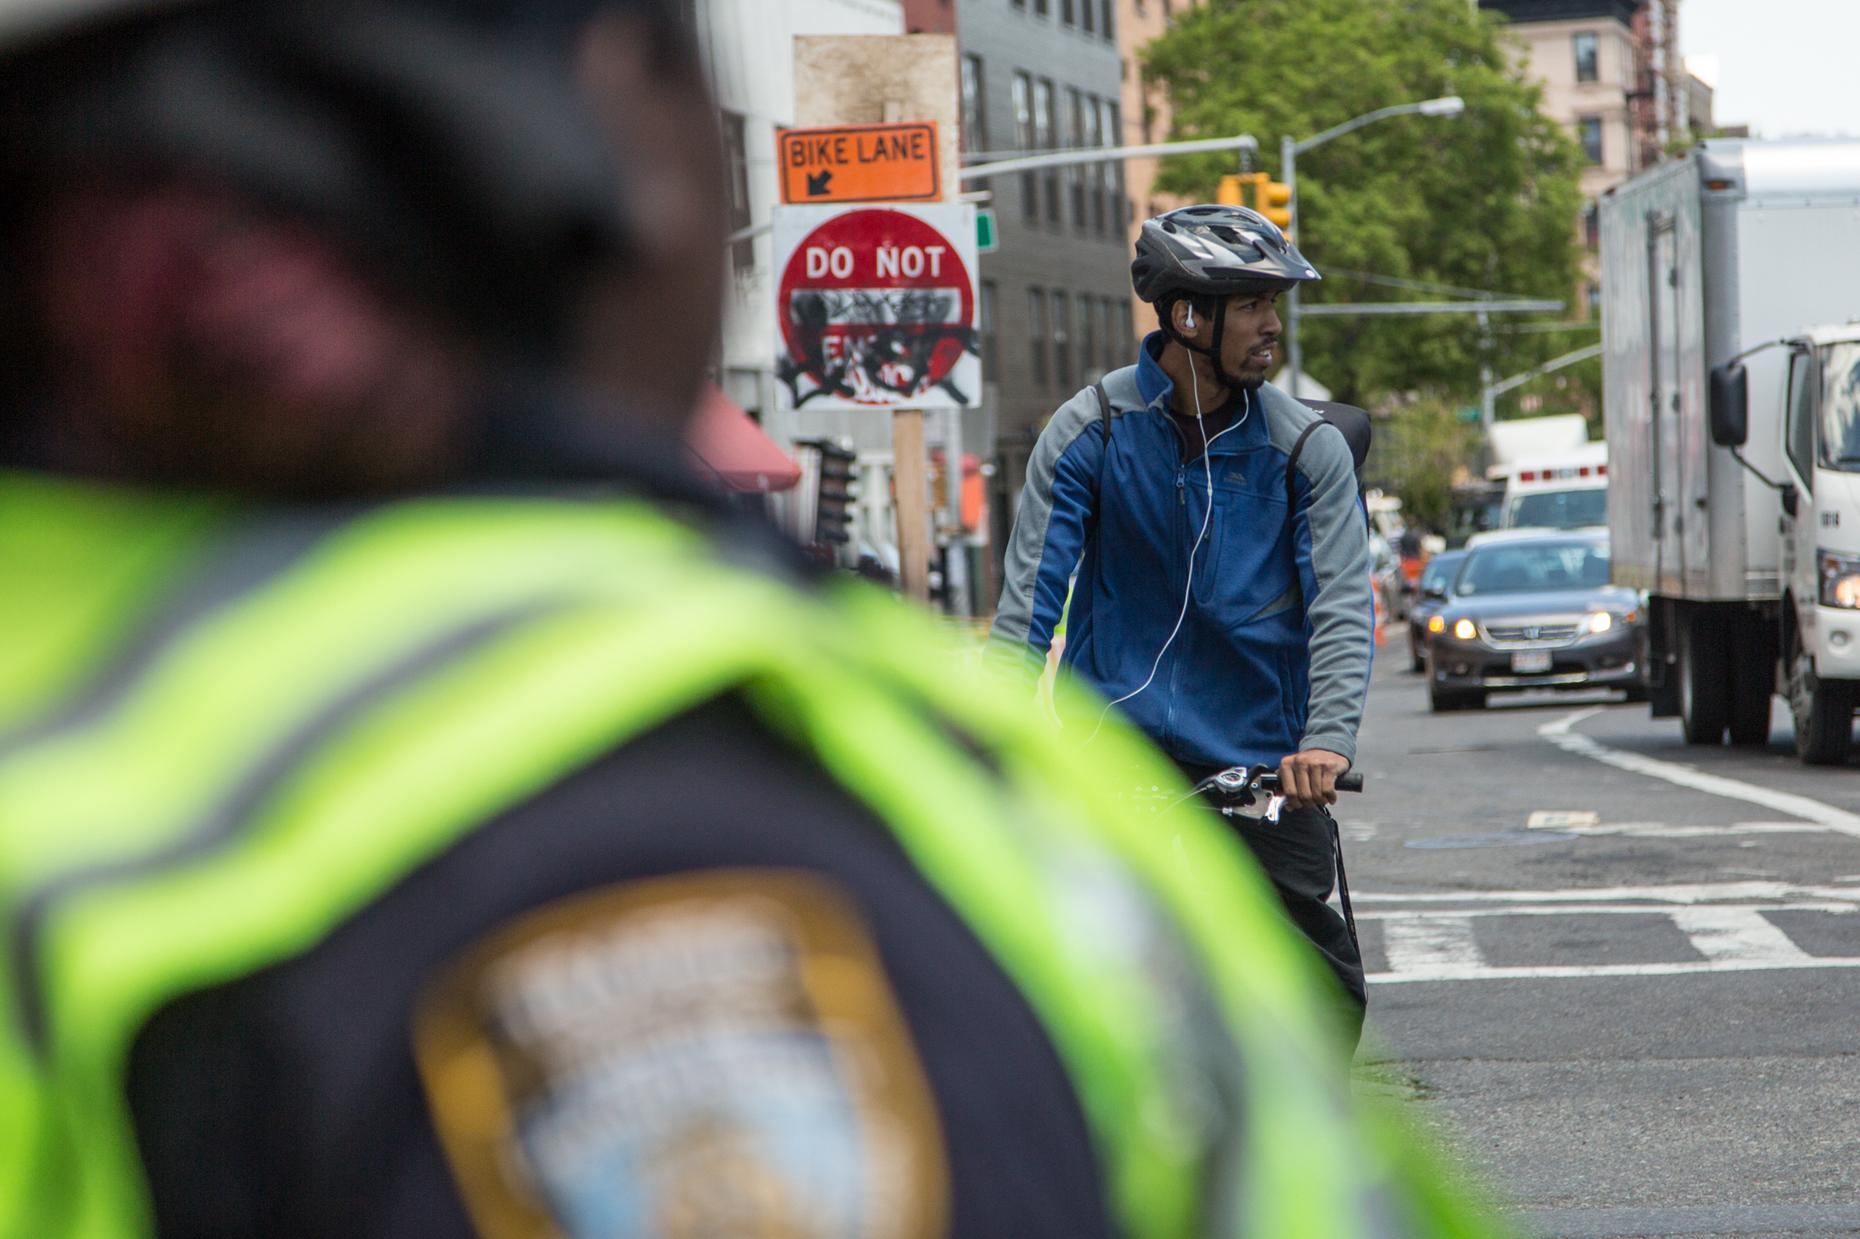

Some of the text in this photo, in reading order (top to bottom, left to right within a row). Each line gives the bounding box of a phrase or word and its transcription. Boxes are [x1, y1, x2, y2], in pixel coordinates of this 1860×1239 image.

[791, 133, 925, 167] BIKE LANE
[806, 246, 946, 278] DO NOT
